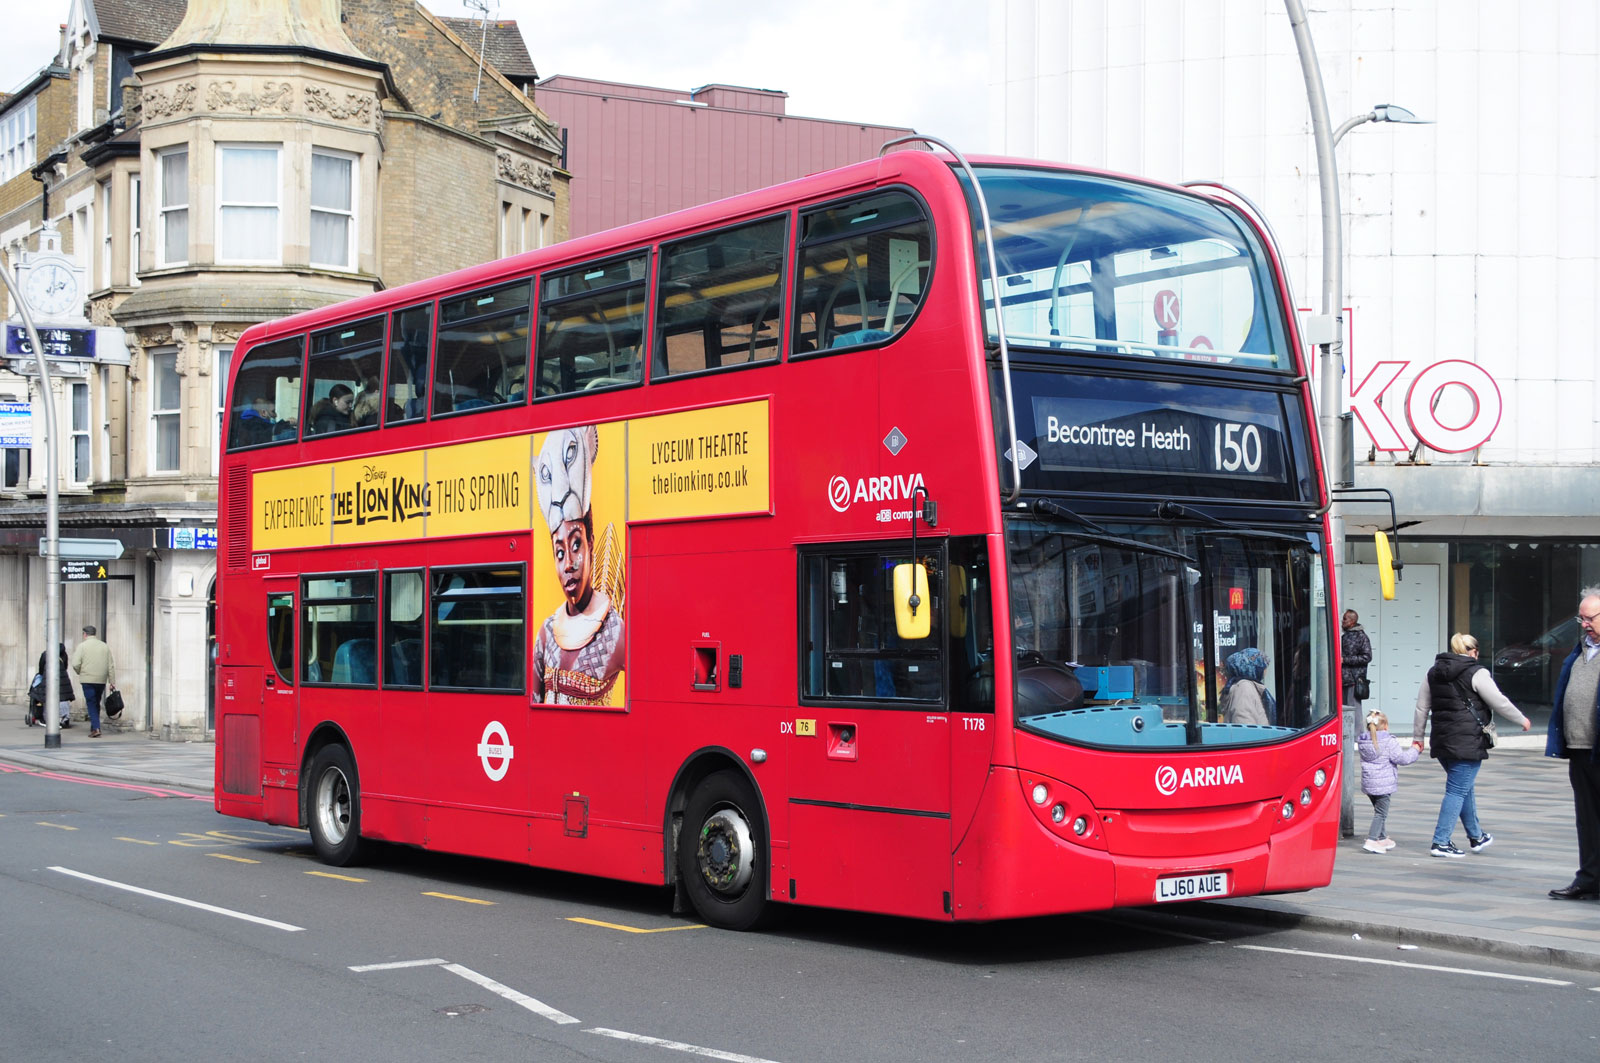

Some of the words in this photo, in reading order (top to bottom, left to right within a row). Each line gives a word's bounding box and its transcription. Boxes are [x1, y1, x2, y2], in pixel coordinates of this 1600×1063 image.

[1162, 295, 1178, 323] K
[1298, 308, 1502, 453] ko
[652, 438, 694, 465] LYCEUM
[698, 431, 749, 460] THEATRE
[1047, 415, 1136, 448] Becontree
[1141, 422, 1191, 452] Heath
[1214, 423, 1262, 473] 150
[652, 465, 748, 495] thelionking.co.uk
[853, 473, 926, 503] ARRIVA
[264, 494, 325, 531] EXPERIENCE
[331, 491, 353, 516] THE
[356, 481, 389, 526] LION
[392, 476, 432, 523] KING
[436, 477, 466, 514] THIS
[469, 471, 519, 512] SPRING
[780, 721, 793, 734] DX
[800, 721, 810, 732] 76
[962, 717, 986, 731] T178
[1320, 732, 1337, 747] T178
[1180, 764, 1244, 788] ARRIVA
[1160, 879, 1195, 898] LJ60
[1198, 875, 1222, 894] AUE
